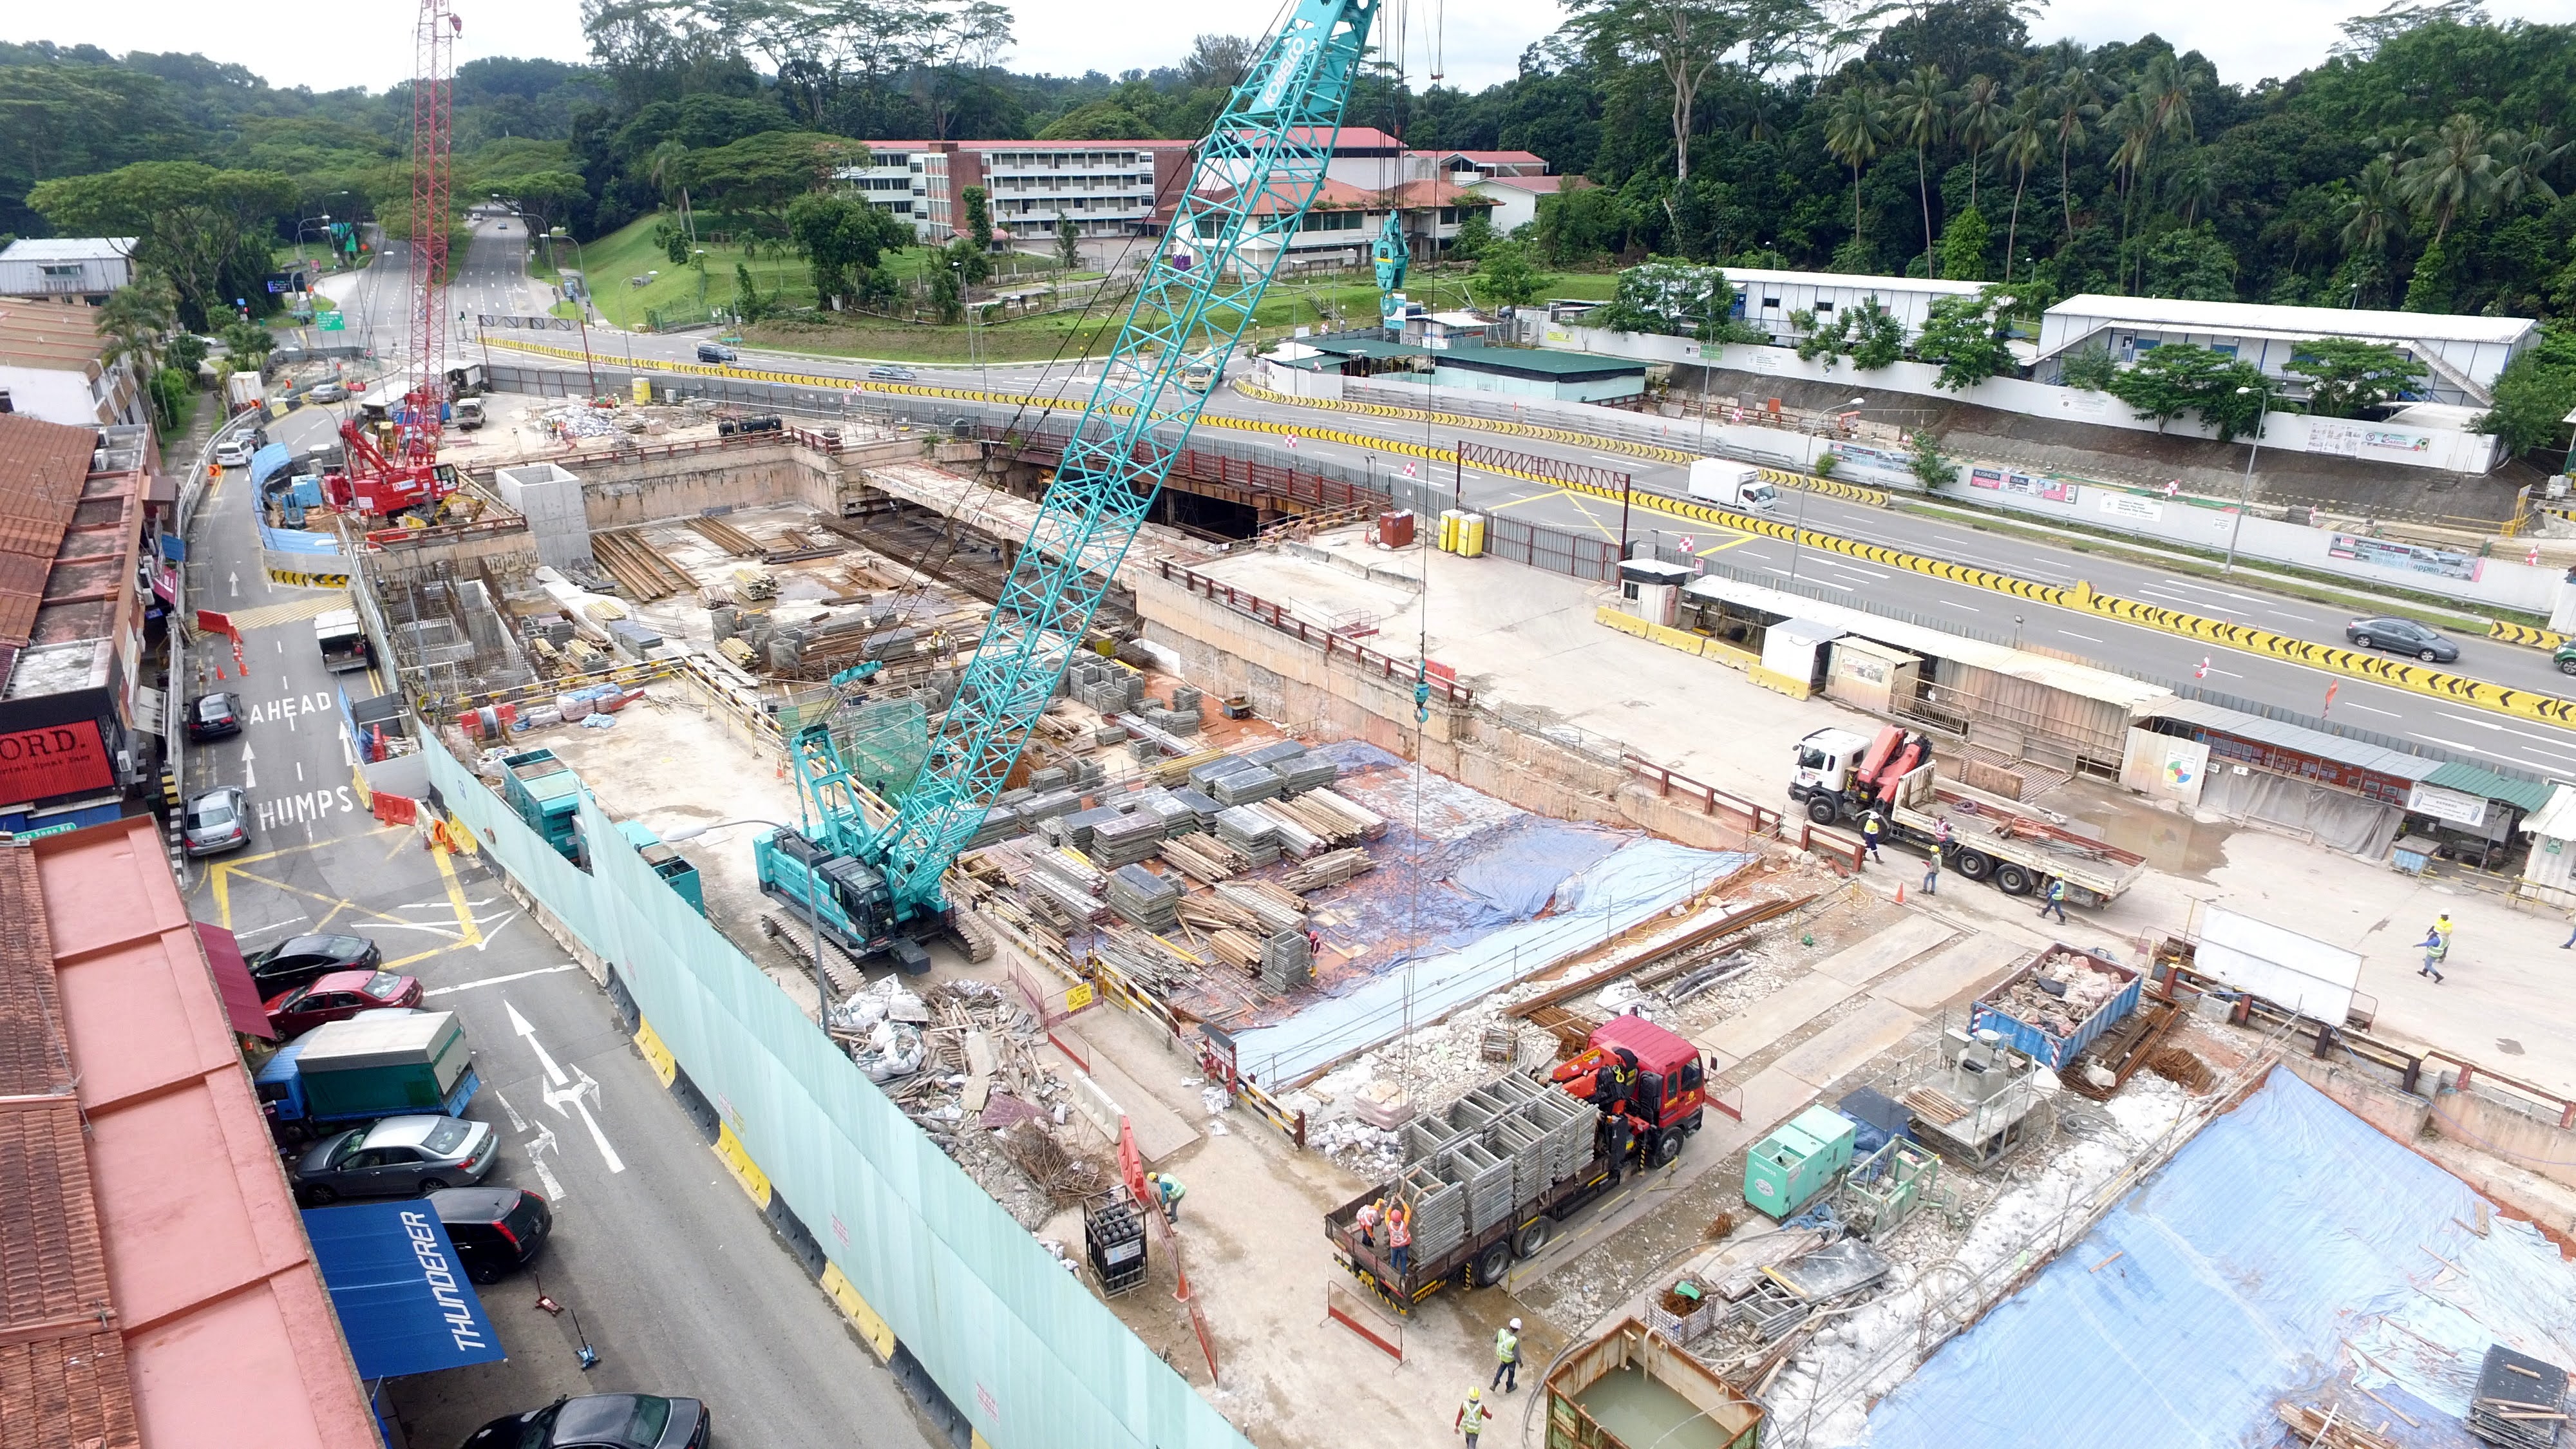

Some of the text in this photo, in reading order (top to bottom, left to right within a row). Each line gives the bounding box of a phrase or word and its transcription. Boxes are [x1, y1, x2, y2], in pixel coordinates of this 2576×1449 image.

[1262, 37, 1305, 108] KOBELCO
[2406, 560, 2439, 574] Happen
[250, 692, 332, 724] AHEAD
[258, 786, 353, 831] HUMPS
[400, 1211, 486, 1350] THUNDERER
